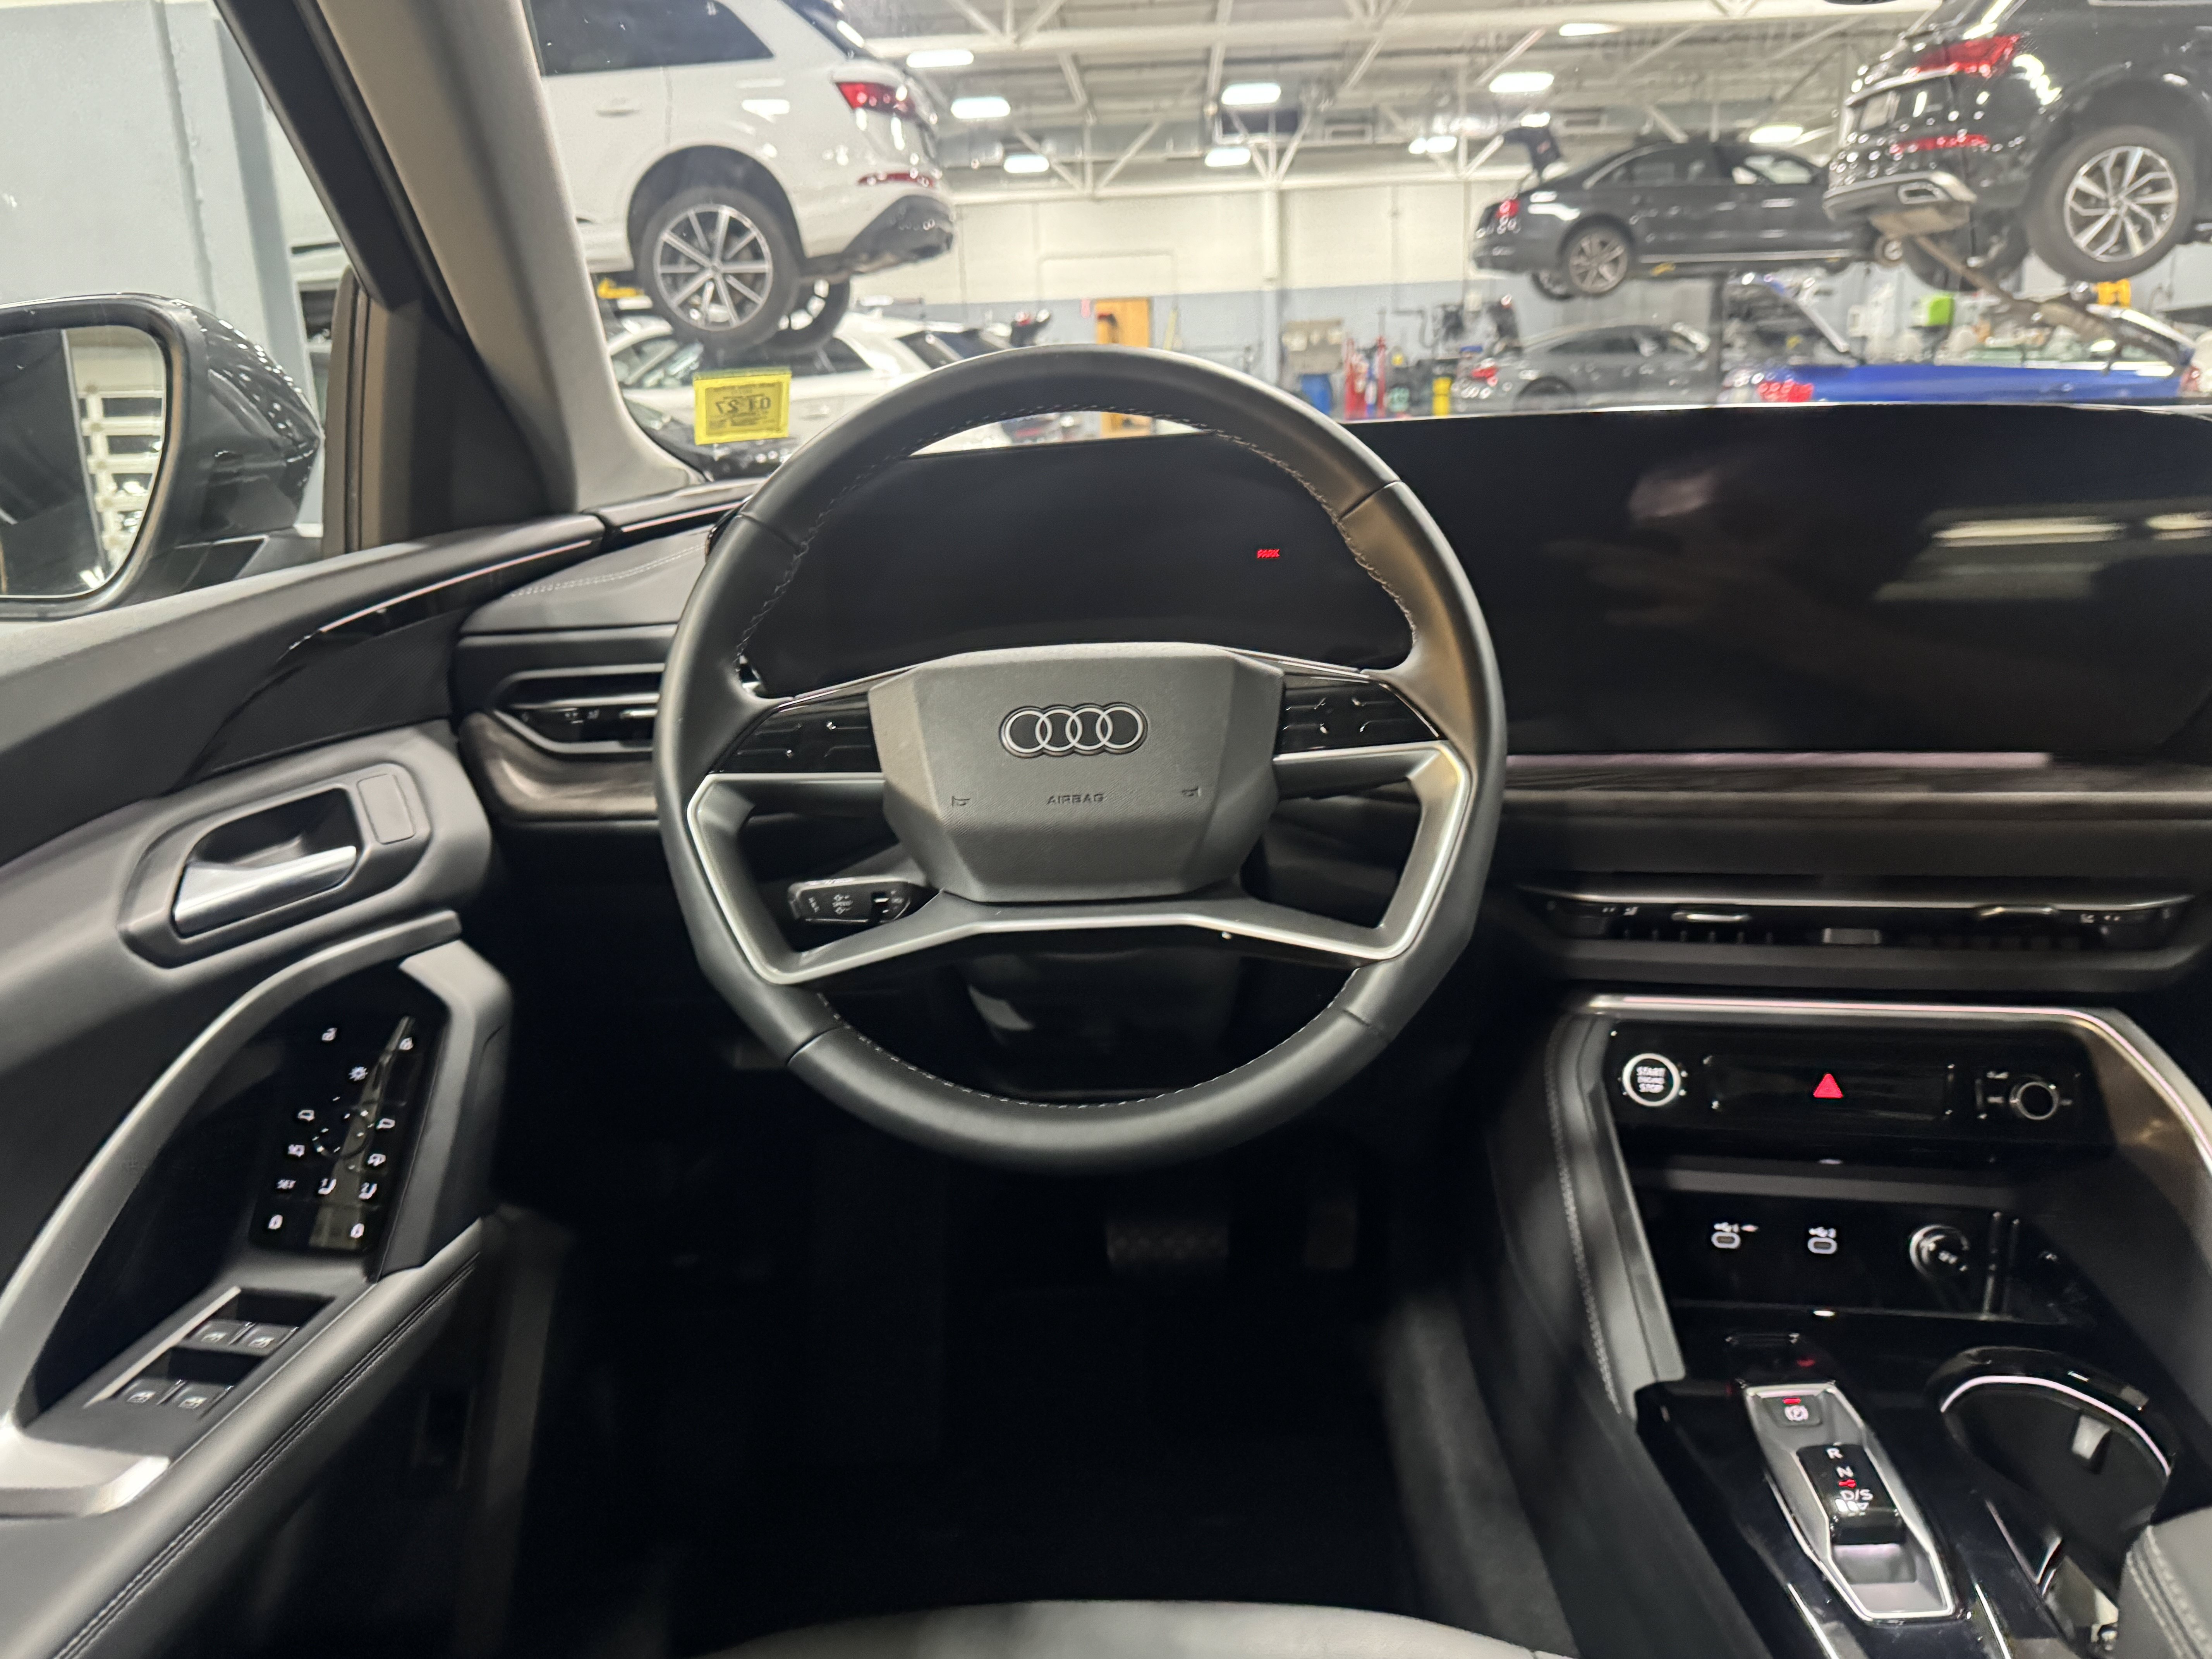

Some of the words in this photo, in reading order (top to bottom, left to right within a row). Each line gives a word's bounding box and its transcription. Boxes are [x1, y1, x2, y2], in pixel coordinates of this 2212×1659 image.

[1046, 793, 1104, 804] AIRBAG
[1636, 1066, 1666, 1076] START
[1826, 1448, 1843, 1459] R
[1836, 1466, 1854, 1478] N
[1840, 1489, 1874, 1501] D/S
